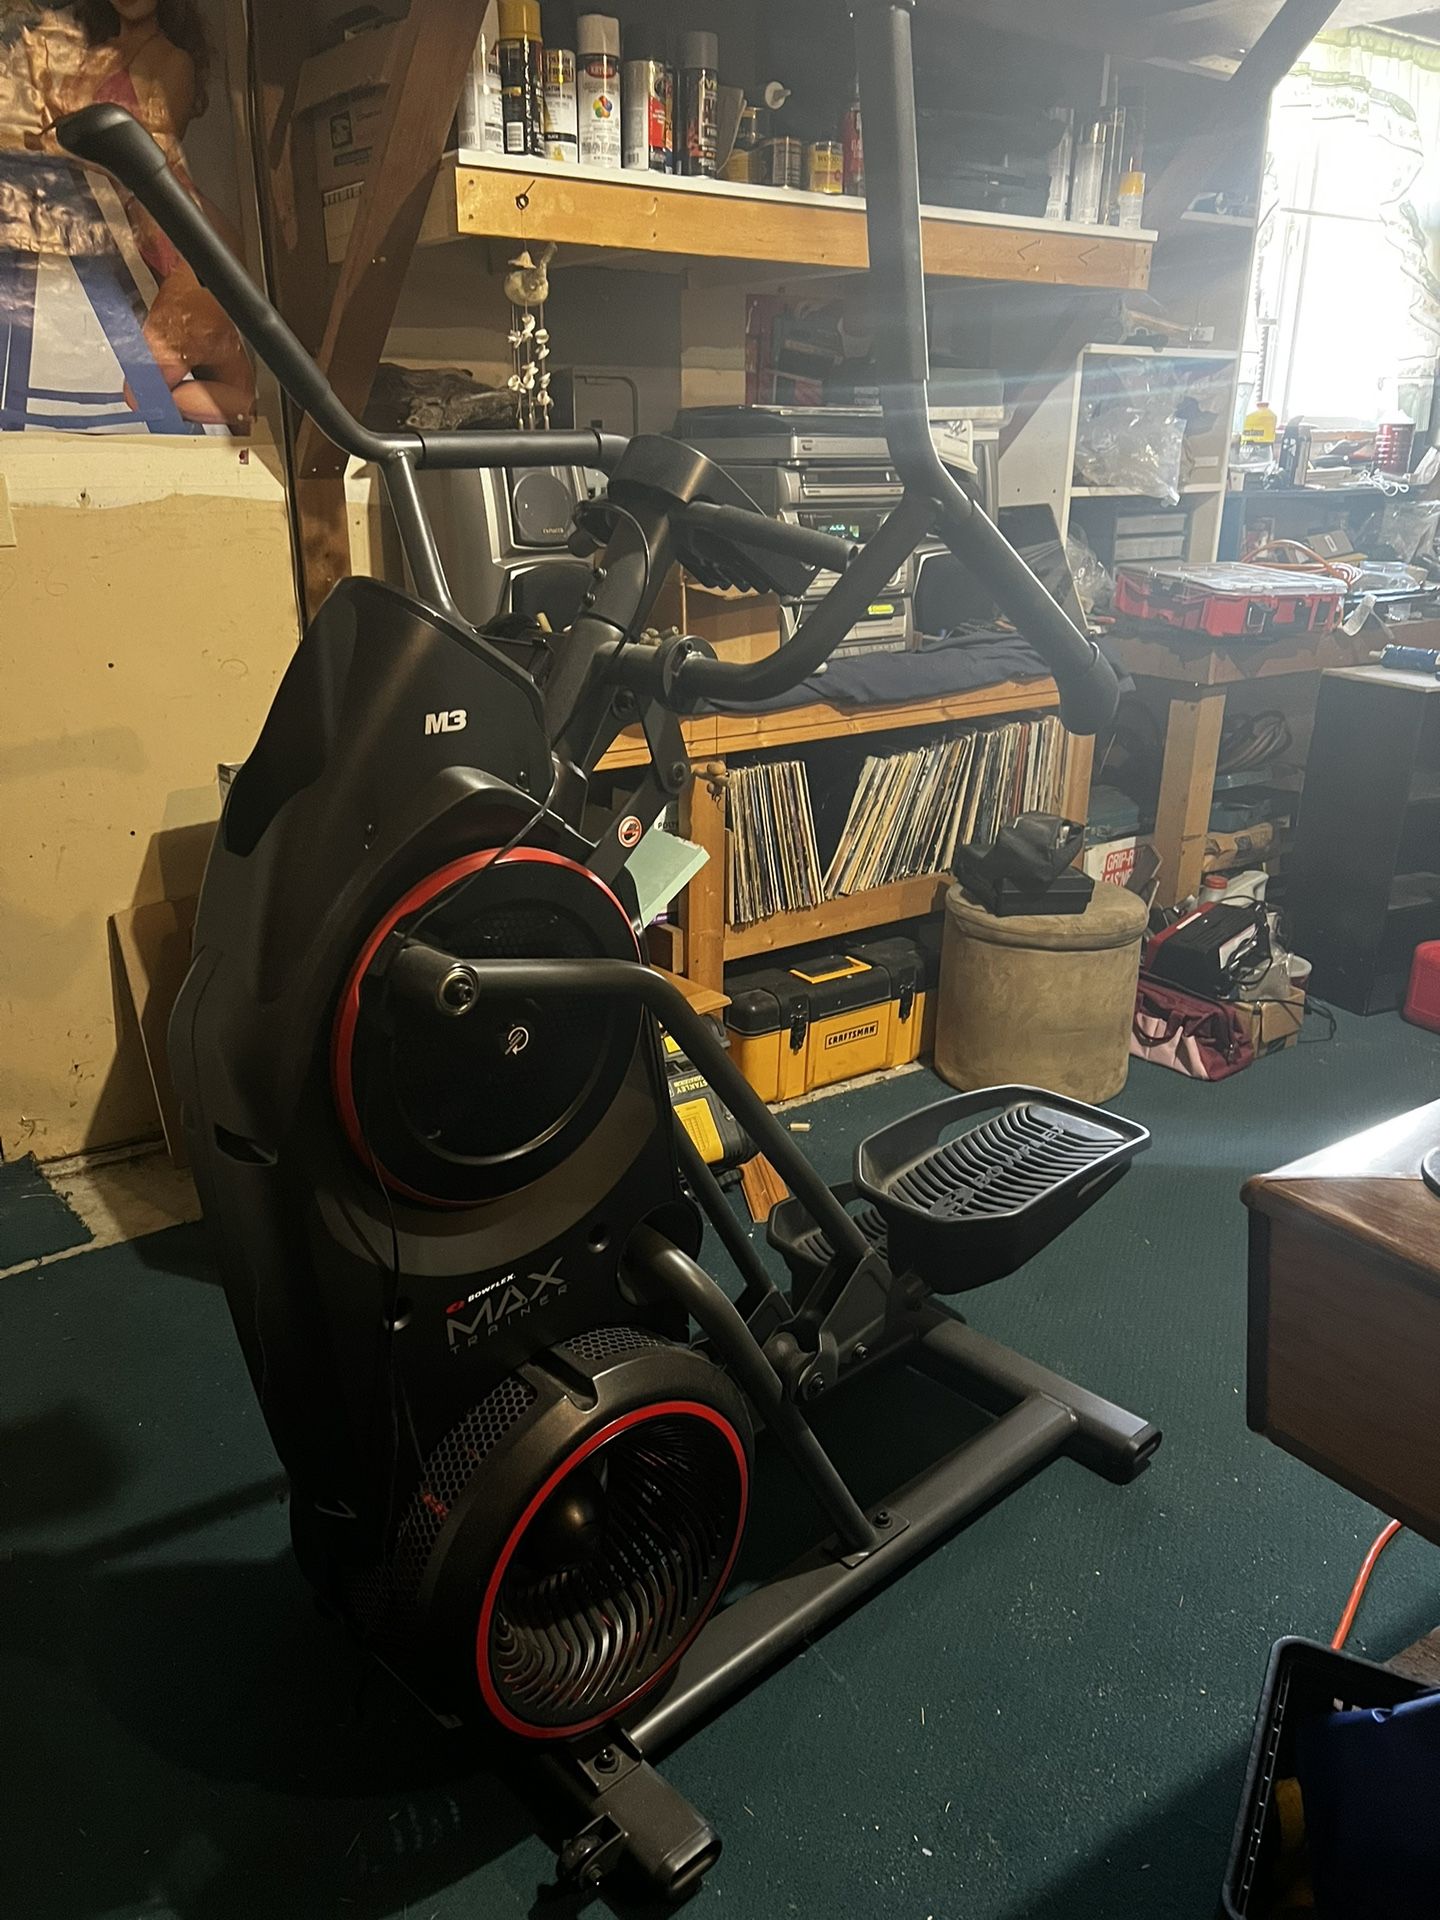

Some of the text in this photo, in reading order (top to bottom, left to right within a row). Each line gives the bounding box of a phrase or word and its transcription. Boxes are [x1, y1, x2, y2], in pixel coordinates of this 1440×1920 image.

[425, 709, 467, 735] M3
[828, 1025, 876, 1046] CRAFTSMAN
[972, 1124, 1065, 1189] BOWFLEX
[446, 1256, 564, 1346] MAX
[468, 1272, 514, 1303] BOWFLEX
[450, 1284, 568, 1355] TRAINER
